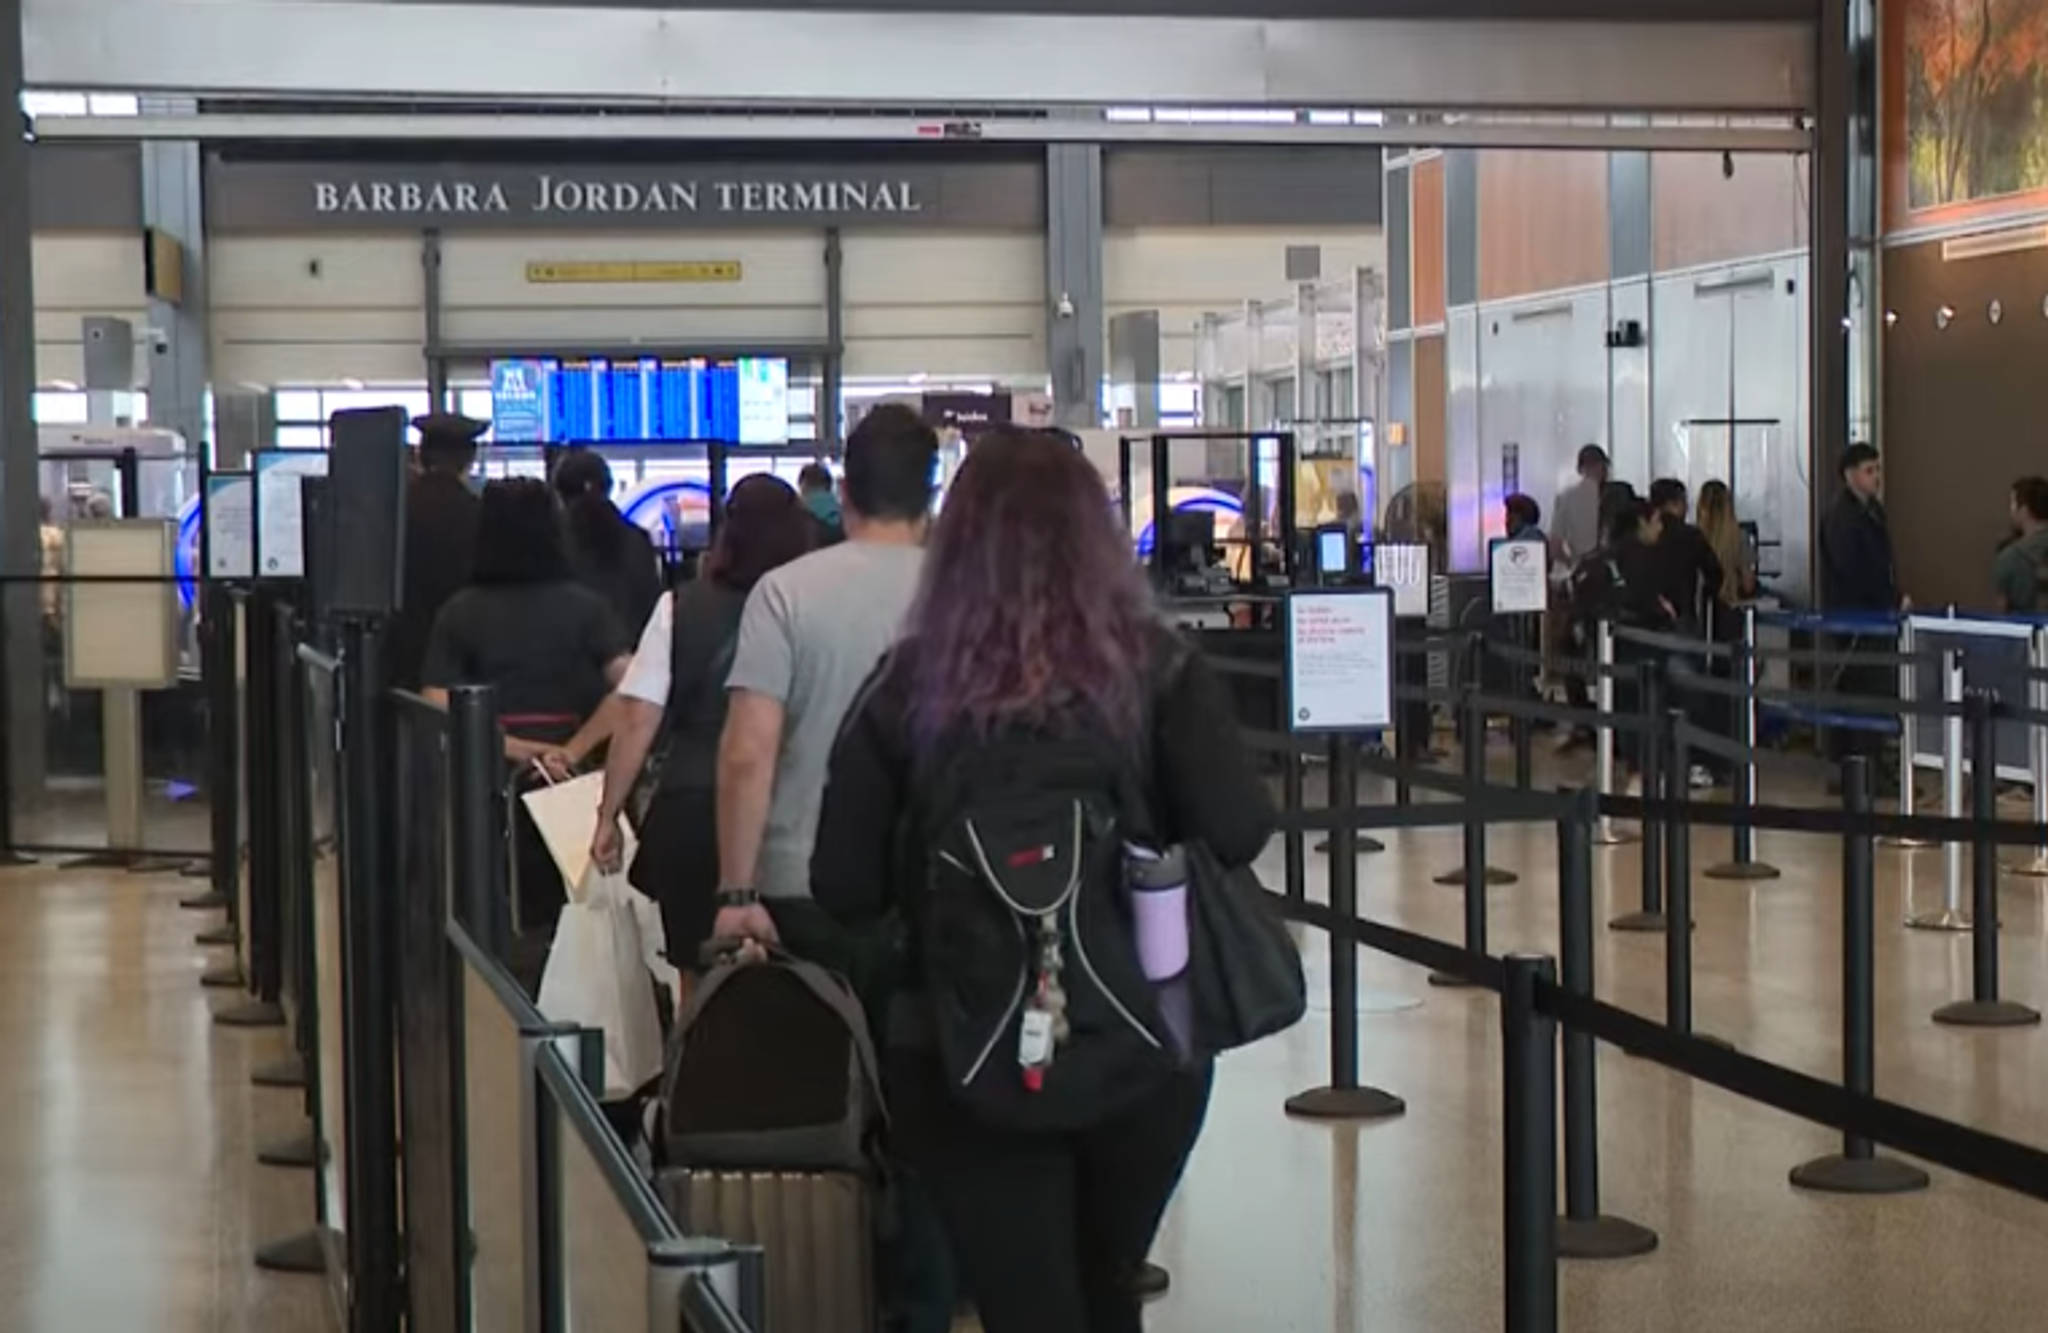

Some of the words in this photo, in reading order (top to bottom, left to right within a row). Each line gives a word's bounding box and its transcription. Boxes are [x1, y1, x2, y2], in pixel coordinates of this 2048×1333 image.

[314, 182, 509, 212] BARBARA
[532, 175, 698, 212] JORDAN
[713, 182, 921, 212] TERMINAL
